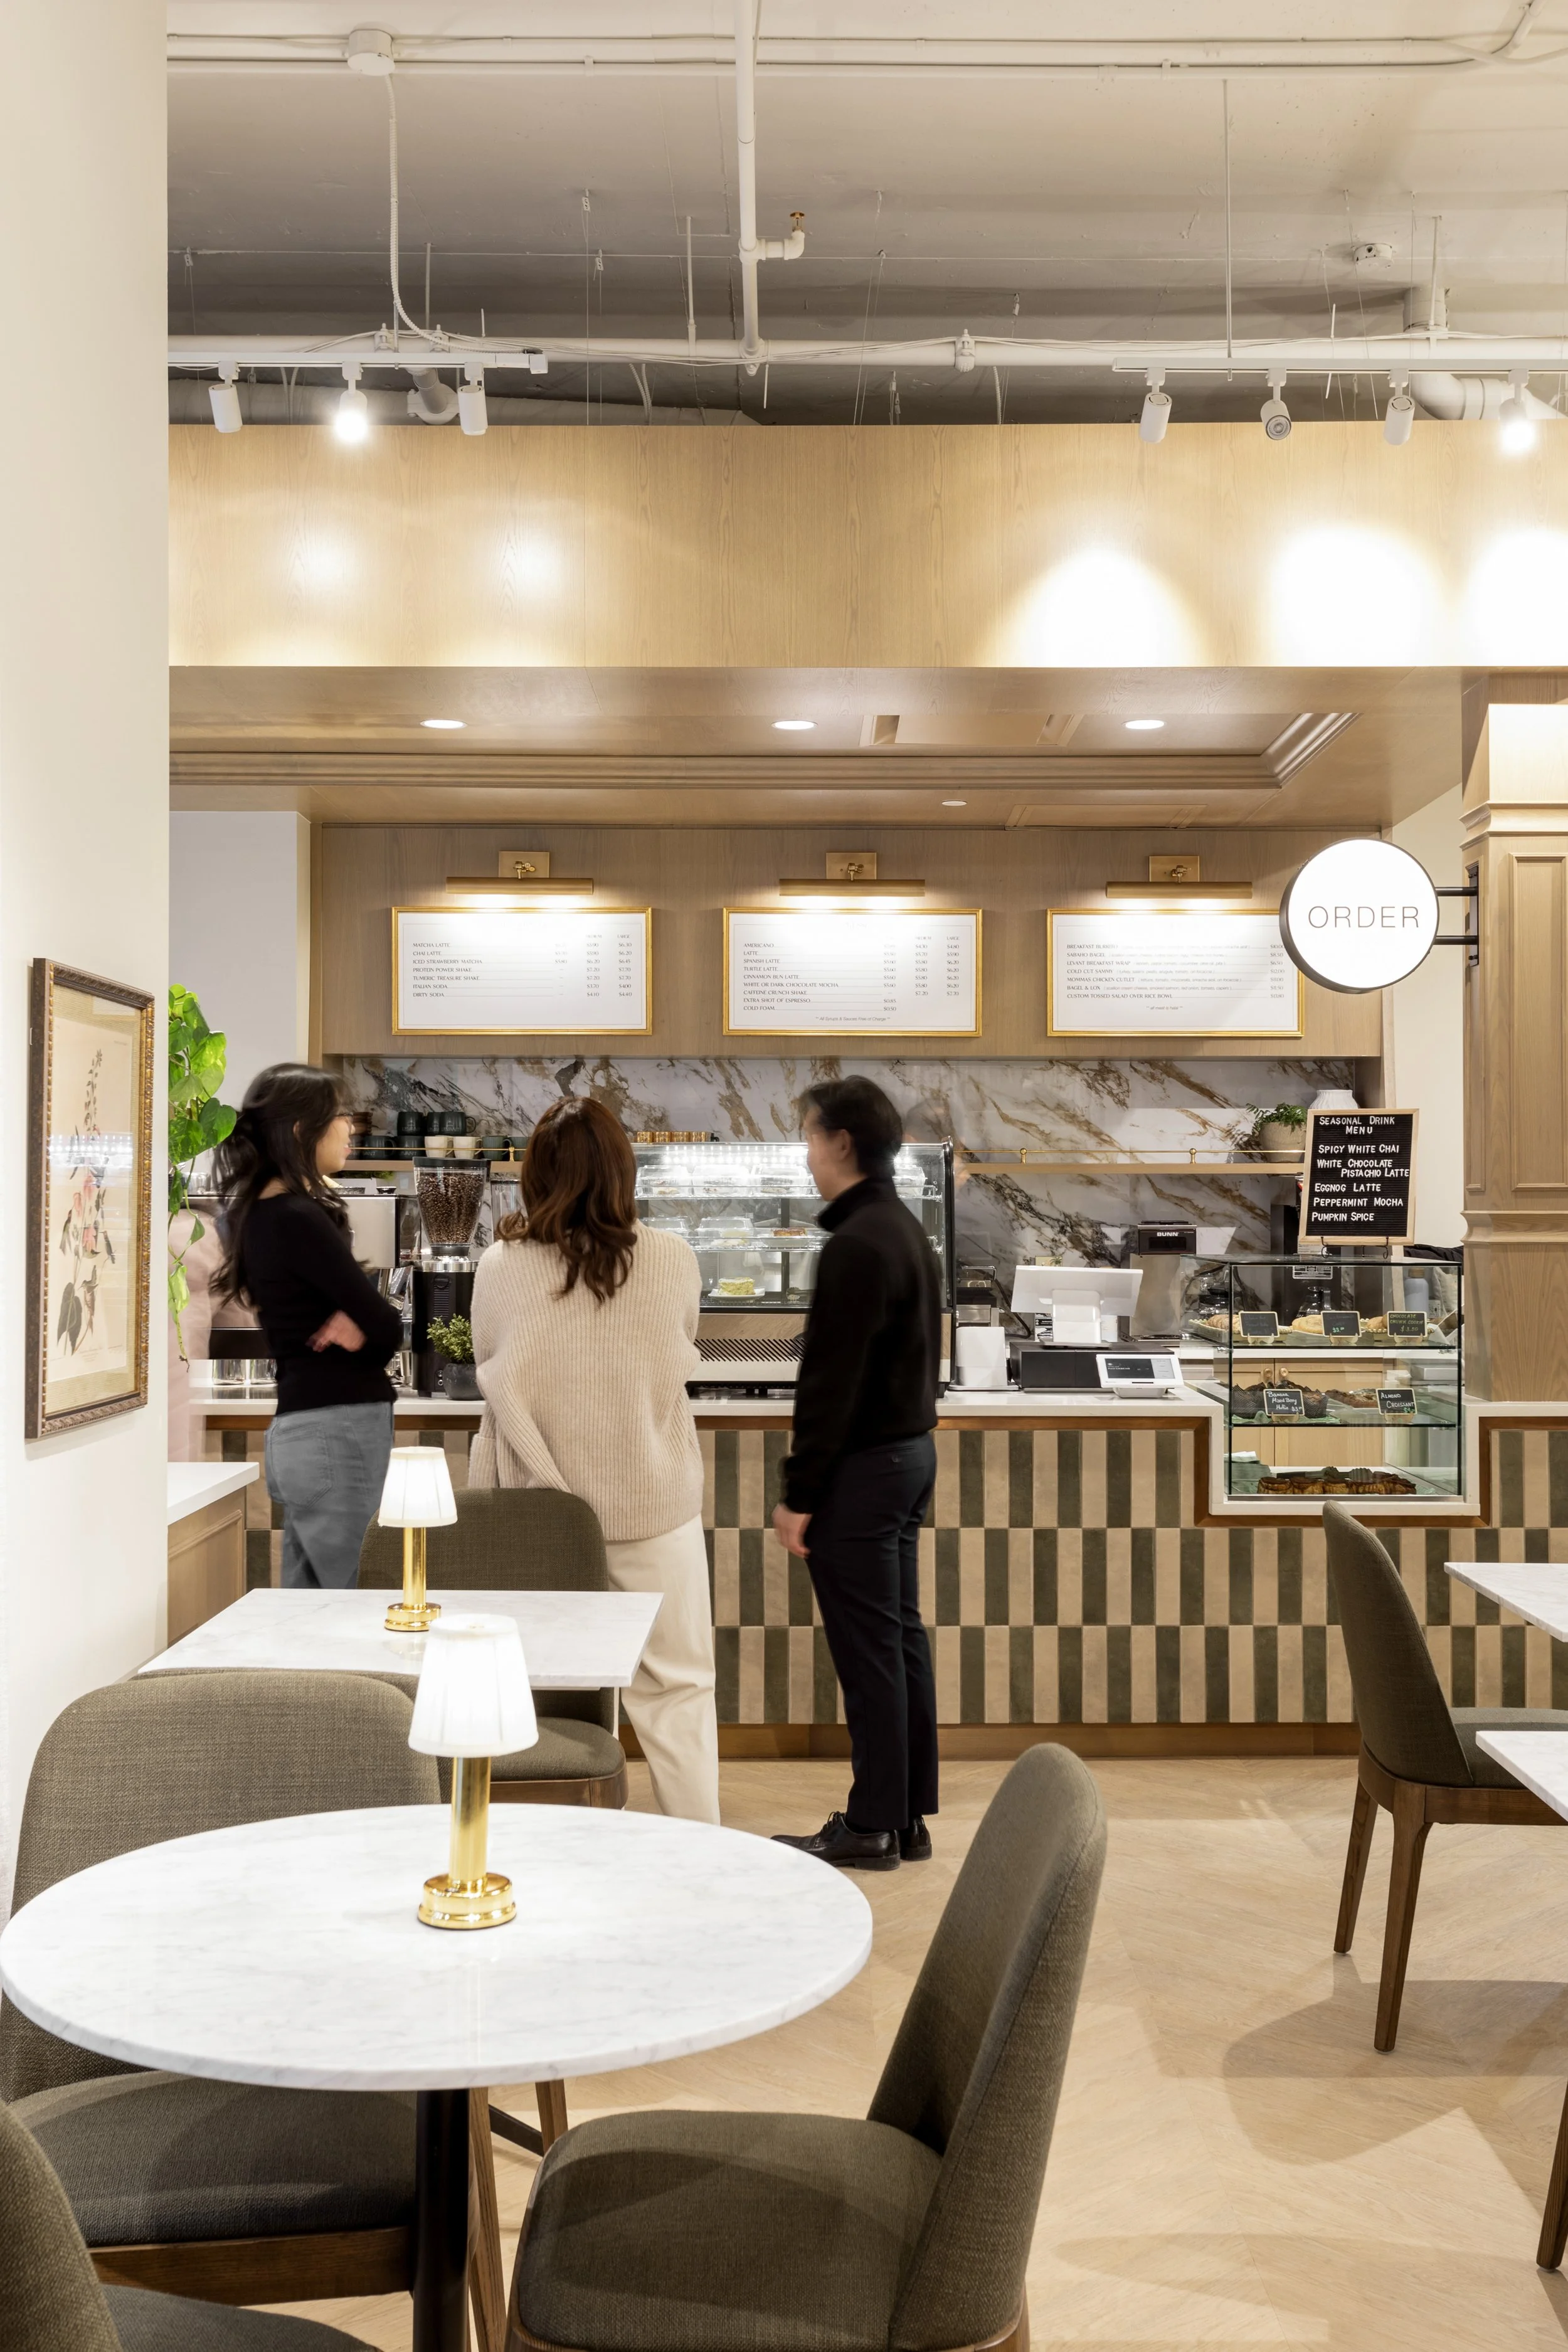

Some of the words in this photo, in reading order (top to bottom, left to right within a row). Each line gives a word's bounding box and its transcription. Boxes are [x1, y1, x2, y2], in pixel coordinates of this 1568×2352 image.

[1308, 906, 1419, 928] ORDER
[1319, 1116, 1362, 1125] SEASONAL
[1369, 1116, 1395, 1125] DRINK
[1345, 1126, 1373, 1135] MENU
[1318, 1145, 1345, 1154] SPICY
[1348, 1145, 1376, 1153] WHITE
[1379, 1144, 1399, 1153] CHAI
[1316, 1159, 1342, 1168] WHITE
[1348, 1158, 1393, 1168] CHOCOLATE
[1341, 1168, 1381, 1178] PISTACHIO
[1384, 1168, 1410, 1177] LATTE
[1315, 1183, 1347, 1192] EGGNOG
[1353, 1183, 1381, 1192] LATTE
[1313, 1197, 1368, 1207] PEPPERMINT
[1374, 1197, 1403, 1207] MOCHA
[1311, 1212, 1347, 1222] PUMPKIN
[1350, 1212, 1375, 1221] SPICE
[1386, 1401, 1415, 1409] CROISSANT
